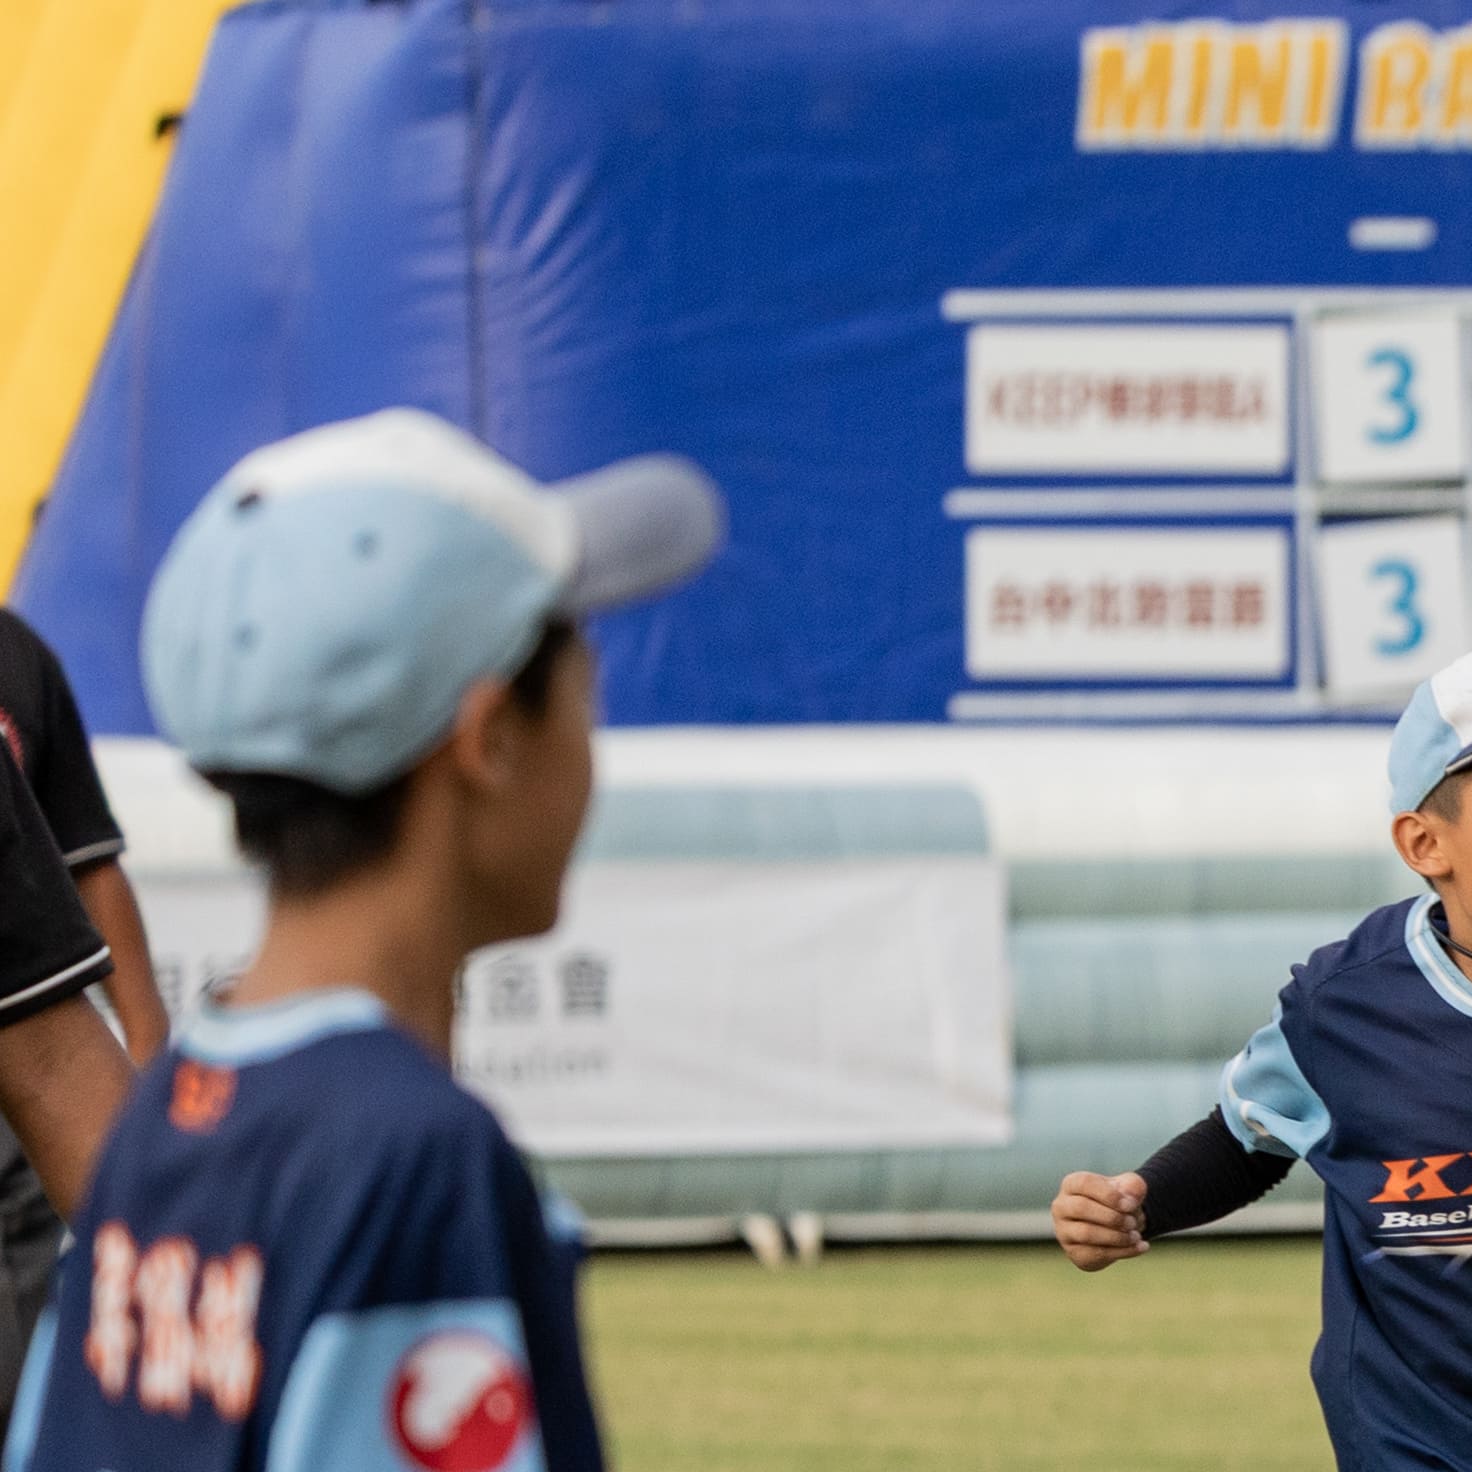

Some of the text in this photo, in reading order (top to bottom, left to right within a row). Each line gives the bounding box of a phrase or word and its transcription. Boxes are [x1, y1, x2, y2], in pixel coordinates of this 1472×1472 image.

[1080, 20, 1346, 148] MINI
[1365, 348, 1423, 446] 3
[1370, 558, 1428, 656] 3
